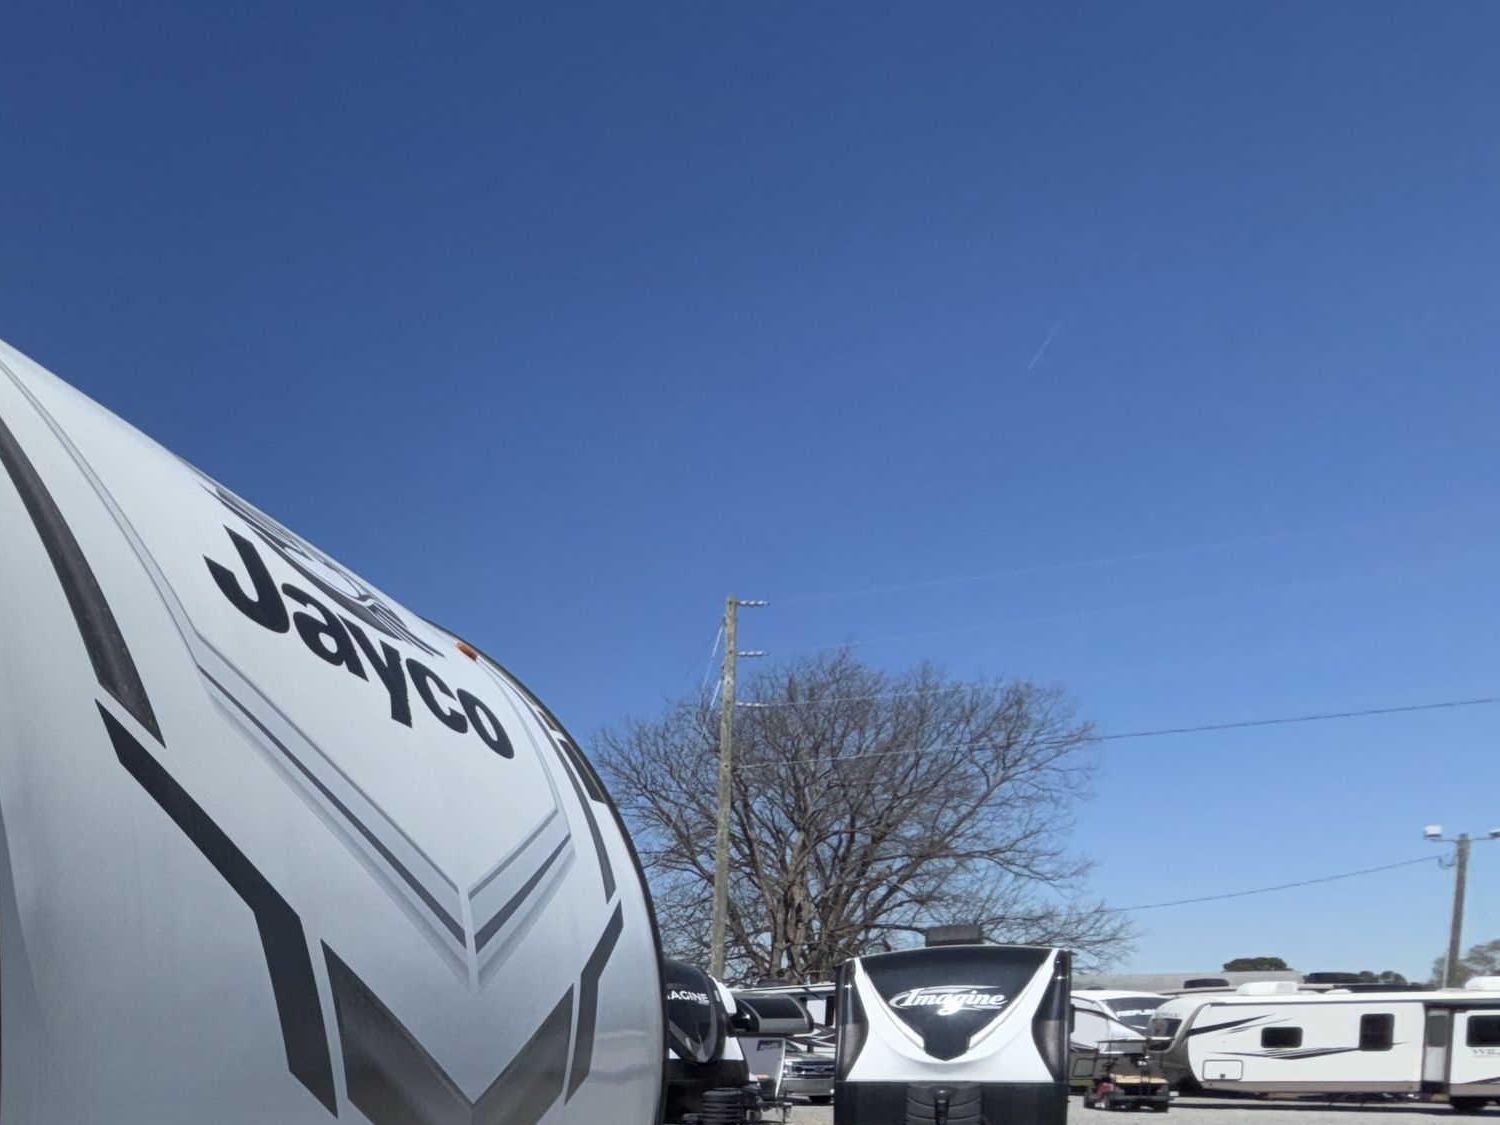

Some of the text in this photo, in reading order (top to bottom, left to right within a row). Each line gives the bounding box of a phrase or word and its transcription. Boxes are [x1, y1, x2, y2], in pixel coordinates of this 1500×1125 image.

[203, 523, 514, 759] Jayco
[667, 990, 709, 1002] AGINE
[899, 986, 1008, 1016] Imagine
